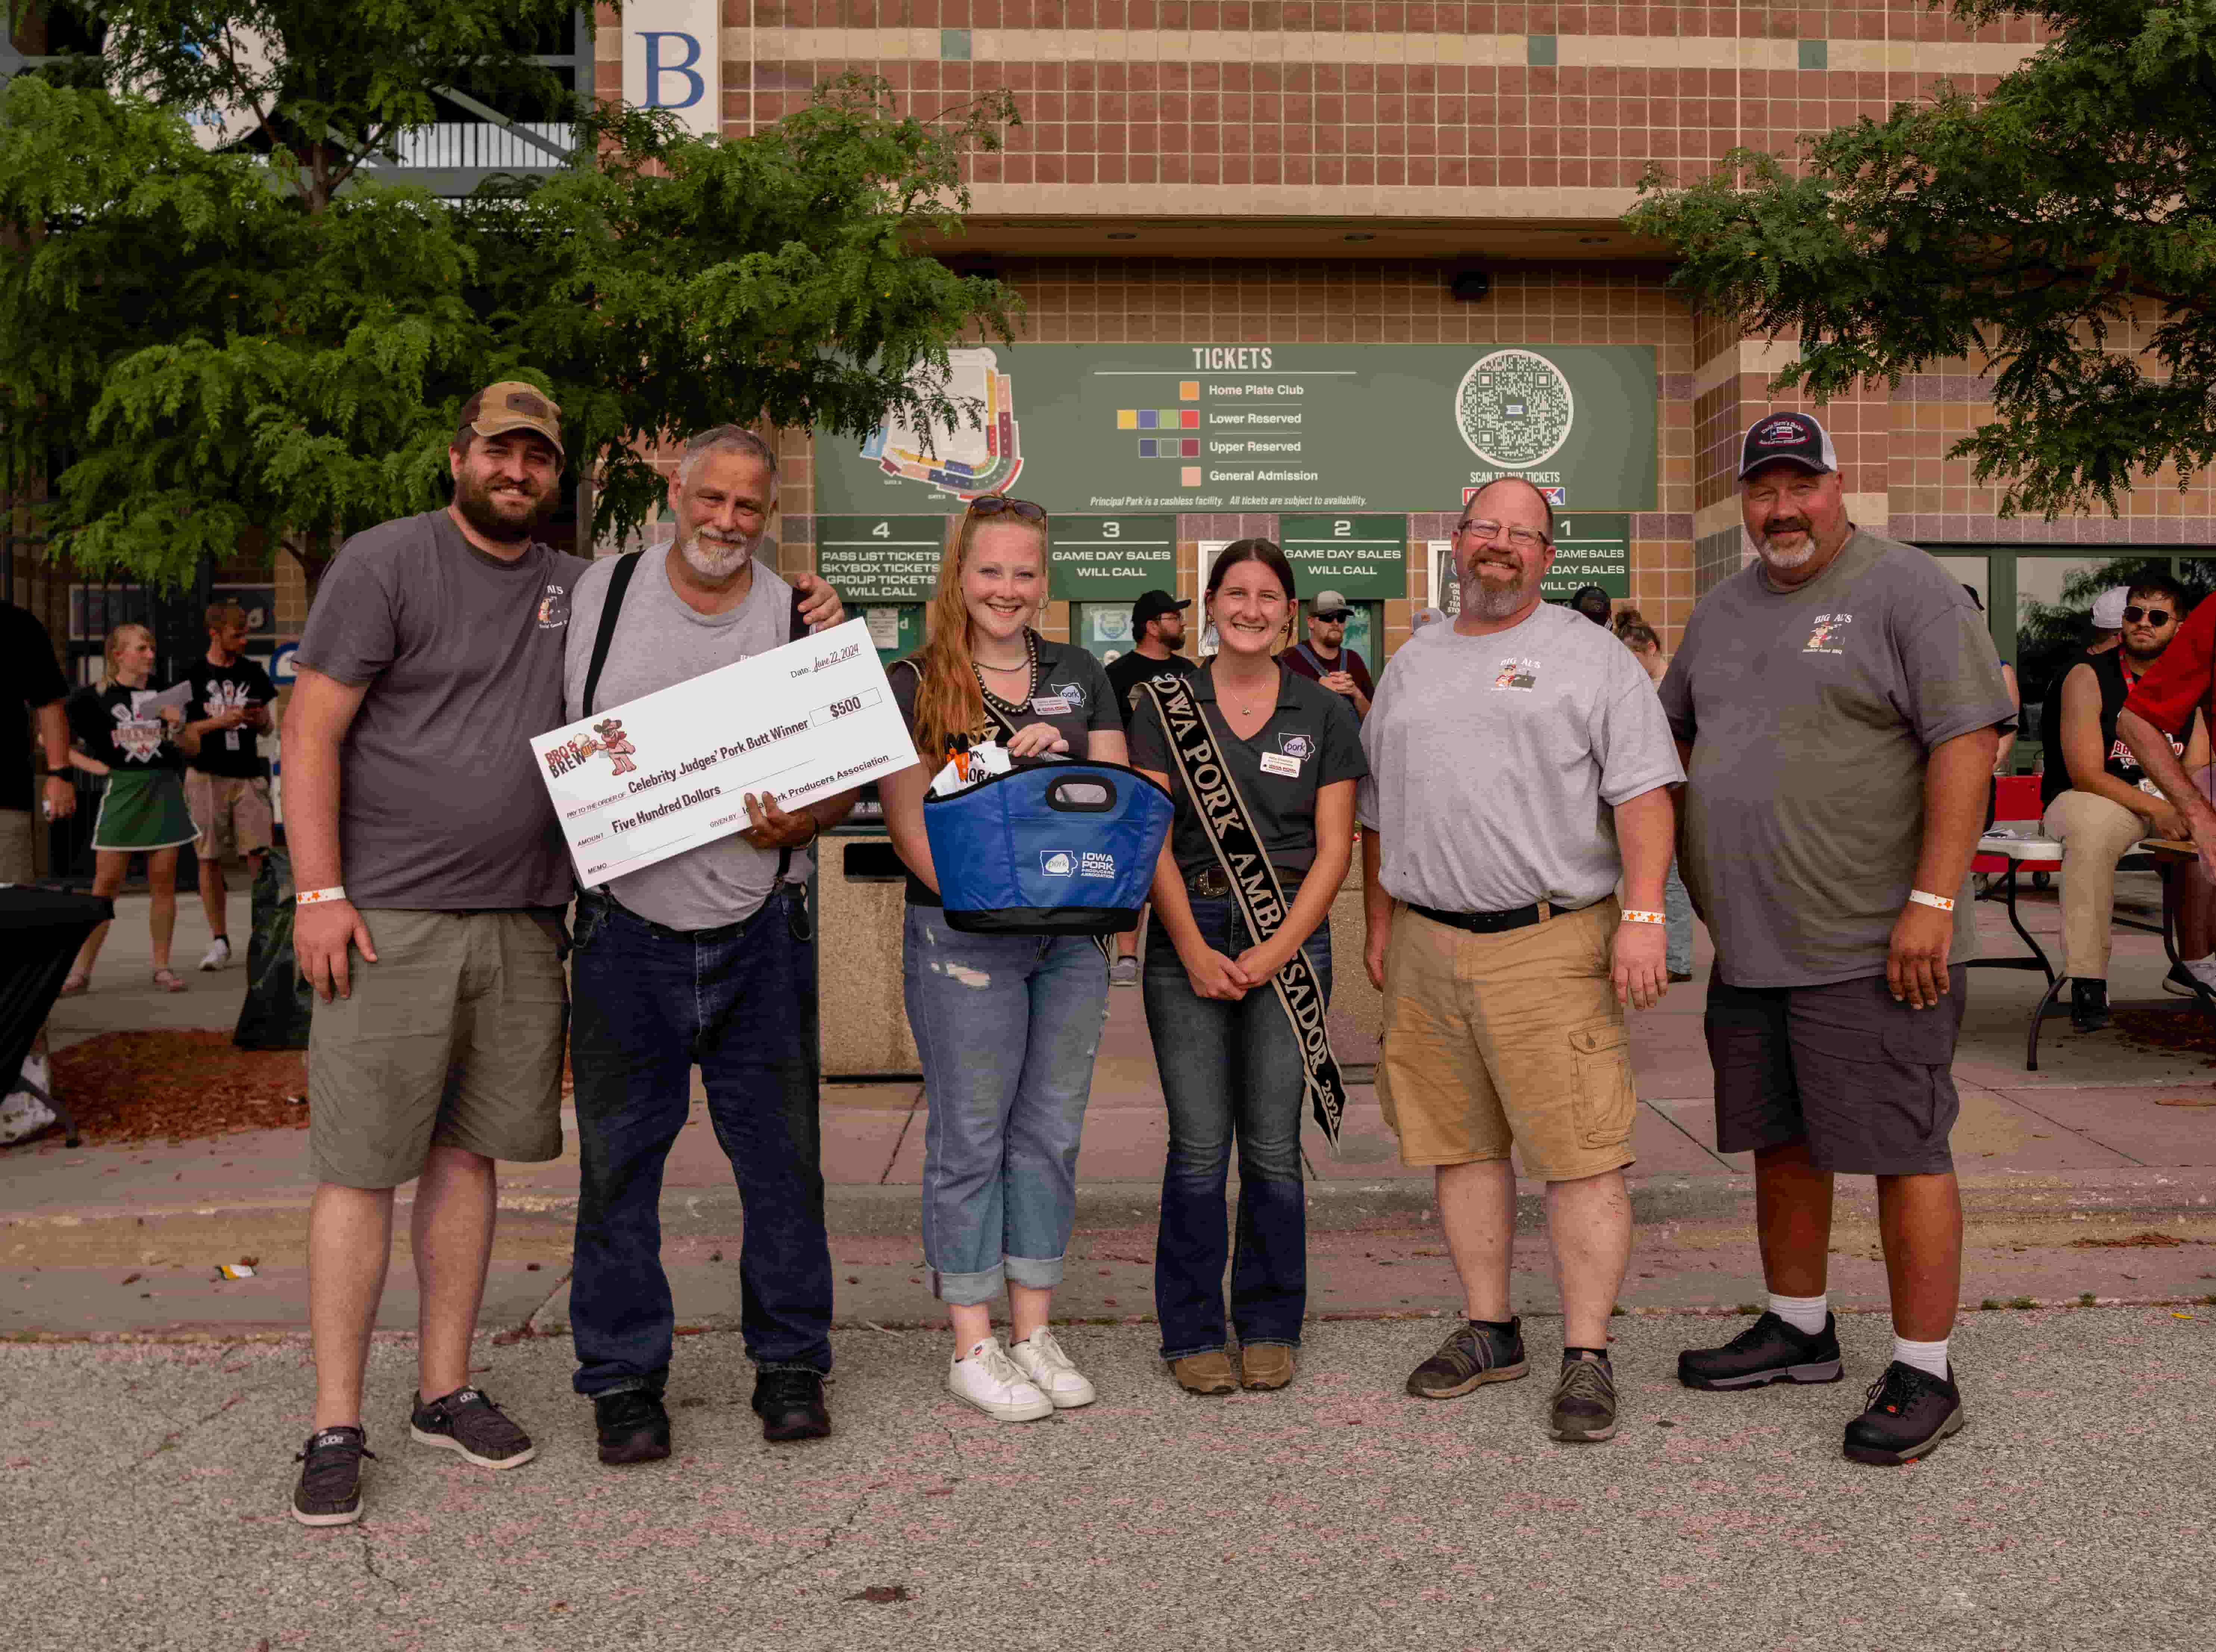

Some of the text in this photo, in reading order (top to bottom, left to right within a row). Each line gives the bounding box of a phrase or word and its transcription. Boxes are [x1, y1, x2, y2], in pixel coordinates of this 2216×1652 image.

[634, 31, 705, 109] B
[1192, 347, 1272, 369] TICKETS
[1209, 385, 1304, 395] Home Plate Club
[1209, 413, 1302, 424] Lower Reserved
[1209, 441, 1301, 453] Upper Reserved
[1209, 470, 1318, 481] General Admission
[1470, 472, 1492, 483] SCAN
[1526, 472, 1560, 483] TICKETS
[1090, 496, 1124, 507] Principal
[1125, 496, 1143, 505] Park
[1145, 496, 1151, 505] is
[1160, 496, 1193, 506] cashless
[1195, 496, 1223, 507] facility.
[1230, 496, 1240, 505] All
[1242, 496, 1268, 505] tickets
[1284, 496, 1313, 507] subject
[1314, 496, 1323, 505] to
[1324, 496, 1367, 507] availability.
[872, 522, 890, 538] 4
[1102, 522, 1120, 538] 3
[1334, 521, 1351, 536] 2
[1560, 521, 1571, 536] 1
[822, 552, 941, 561] PASS LIST TICKETS
[1052, 551, 1171, 560] GAME DAY SALES
[1284, 550, 1401, 559] GAME DAY SALES
[1555, 550, 1624, 558] GAME SALES
[822, 564, 941, 573] SKYBOX TICKETS
[1076, 568, 1147, 577] WILL CALL
[1308, 566, 1377, 575] WILL CALL
[1552, 566, 1579, 574] DAY
[1582, 566, 1624, 574] SALES
[826, 575, 937, 584] GROUP TICKETS
[846, 587, 917, 596] WILL CALL
[1814, 613, 1830, 624] BIG
[790, 642, 859, 678] Date: June 22, 2024
[1062, 689, 1080, 699] pork
[830, 696, 861, 719] $500
[545, 740, 580, 765] BBQ &
[1286, 742, 1305, 752] pork
[549, 751, 586, 778] BREW
[567, 810, 578, 818] PAY
[587, 803, 599, 812] THE
[597, 794, 618, 807] ORDER
[628, 768, 677, 793] Celebrity
[720, 740, 746, 759] Pork
[746, 732, 771, 749] Butt
[770, 719, 809, 740] Winner
[709, 816, 728, 828] GIVEN
[728, 812, 737, 822] BY
[773, 792, 788, 803] ork
[788, 775, 836, 797] Producers
[836, 754, 889, 780] Association
[577, 785, 721, 847] AMOUNT Five Hundred Dollars
[1083, 852, 1114, 863] IOWA
[588, 863, 607, 874] MEMO
[1082, 861, 1114, 870] PORK
[1154, 679, 1198, 741] OWA
[1182, 739, 1244, 839] PORK
[1229, 852, 1329, 1075] AMBSADOR
